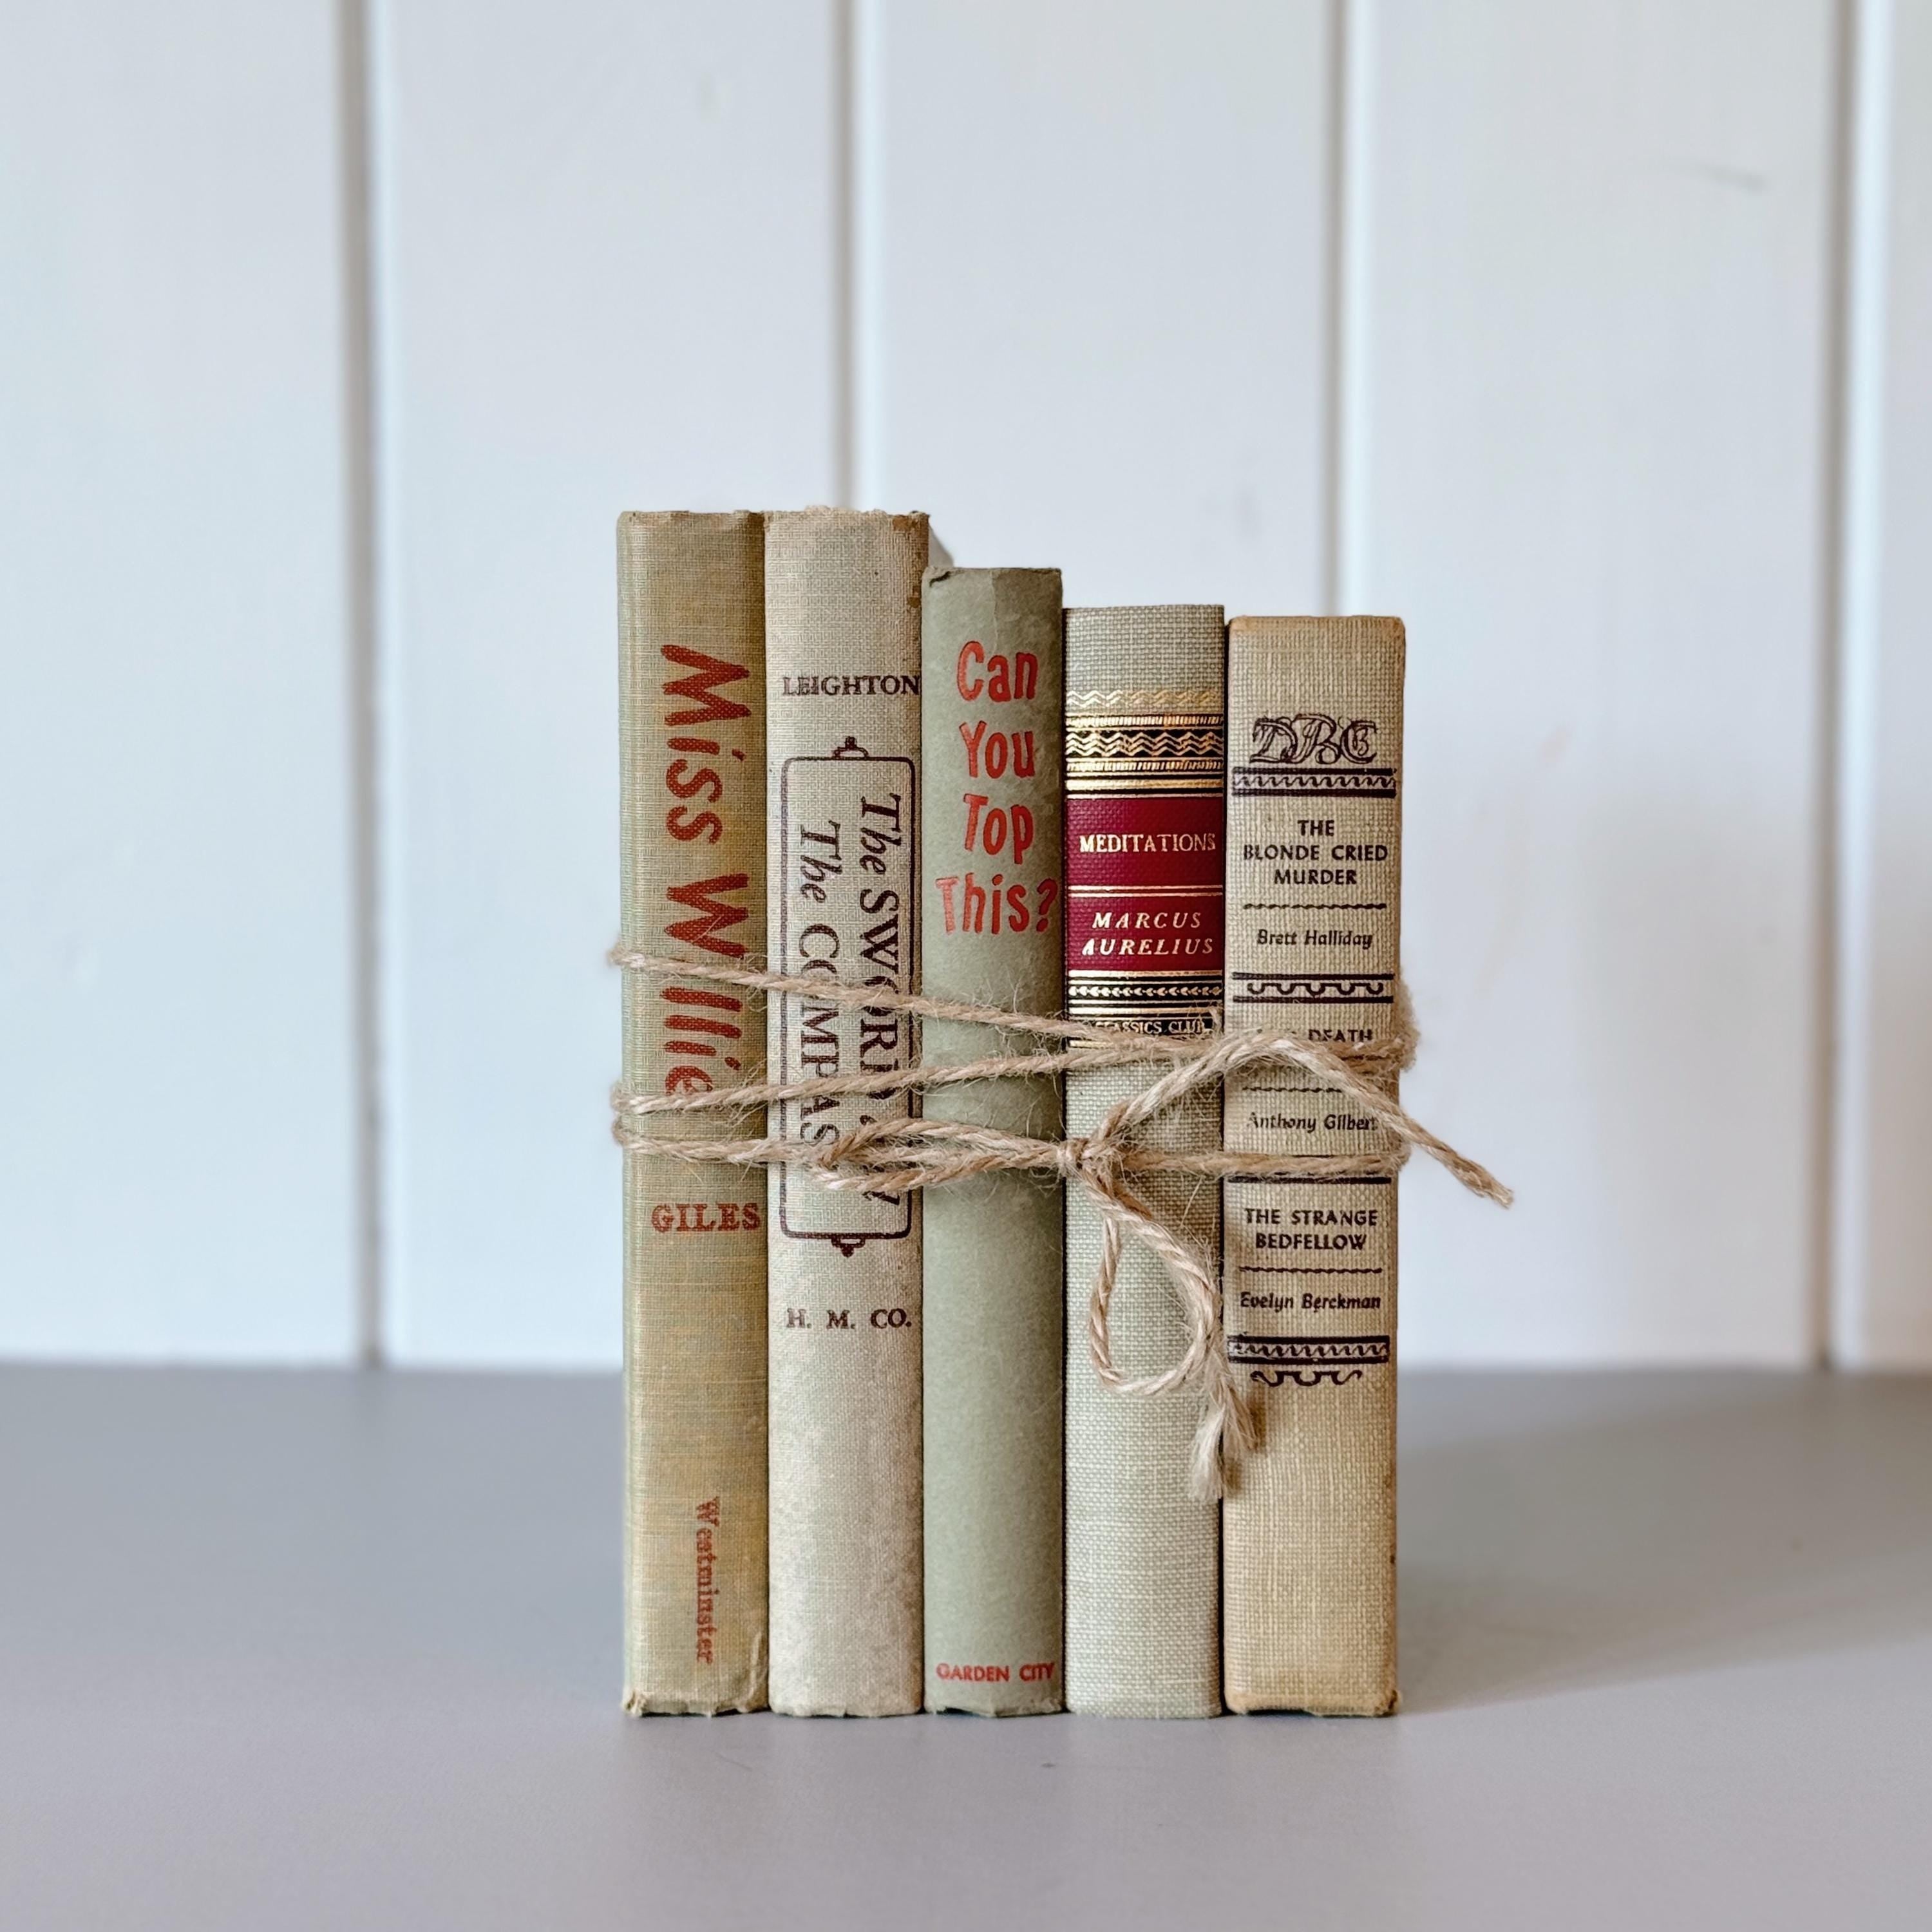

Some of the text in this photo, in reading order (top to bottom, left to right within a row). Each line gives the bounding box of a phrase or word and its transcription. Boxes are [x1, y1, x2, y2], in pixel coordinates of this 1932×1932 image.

[957, 640, 1038, 703] Can
[782, 675, 920, 696] LEIGHTON
[958, 719, 1036, 779] You
[860, 793, 902, 874] The
[962, 793, 1034, 865] Top
[1297, 820, 1334, 837] THE
[1079, 833, 1216, 853] MEDITATIONS
[1244, 844, 1388, 862] BLONDE CRIED
[661, 645, 752, 1096] Miss Willie
[1273, 869, 1357, 885] MURDER
[934, 873, 1058, 935] This?
[1092, 912, 1201, 929] MARCUS
[1082, 938, 1213, 956] AURELIUS
[1257, 929, 1373, 949] Brett Halliday
[799, 820, 842, 1146] The COMPAS
[1308, 1029, 1373, 1043] DEATH
[1247, 1112, 1378, 1133] Anthony Gilbert
[651, 1202, 762, 1233] GILES
[1245, 1208, 1378, 1226] THE STRANGE
[1256, 1234, 1367, 1251] BEDFELLOW
[1240, 1291, 1381, 1312] Evelyn Berckman
[786, 1308, 912, 1330] H. M. CO.
[696, 1495, 720, 1664] Westminster
[936, 1661, 1055, 1682] GARDEN CITY
